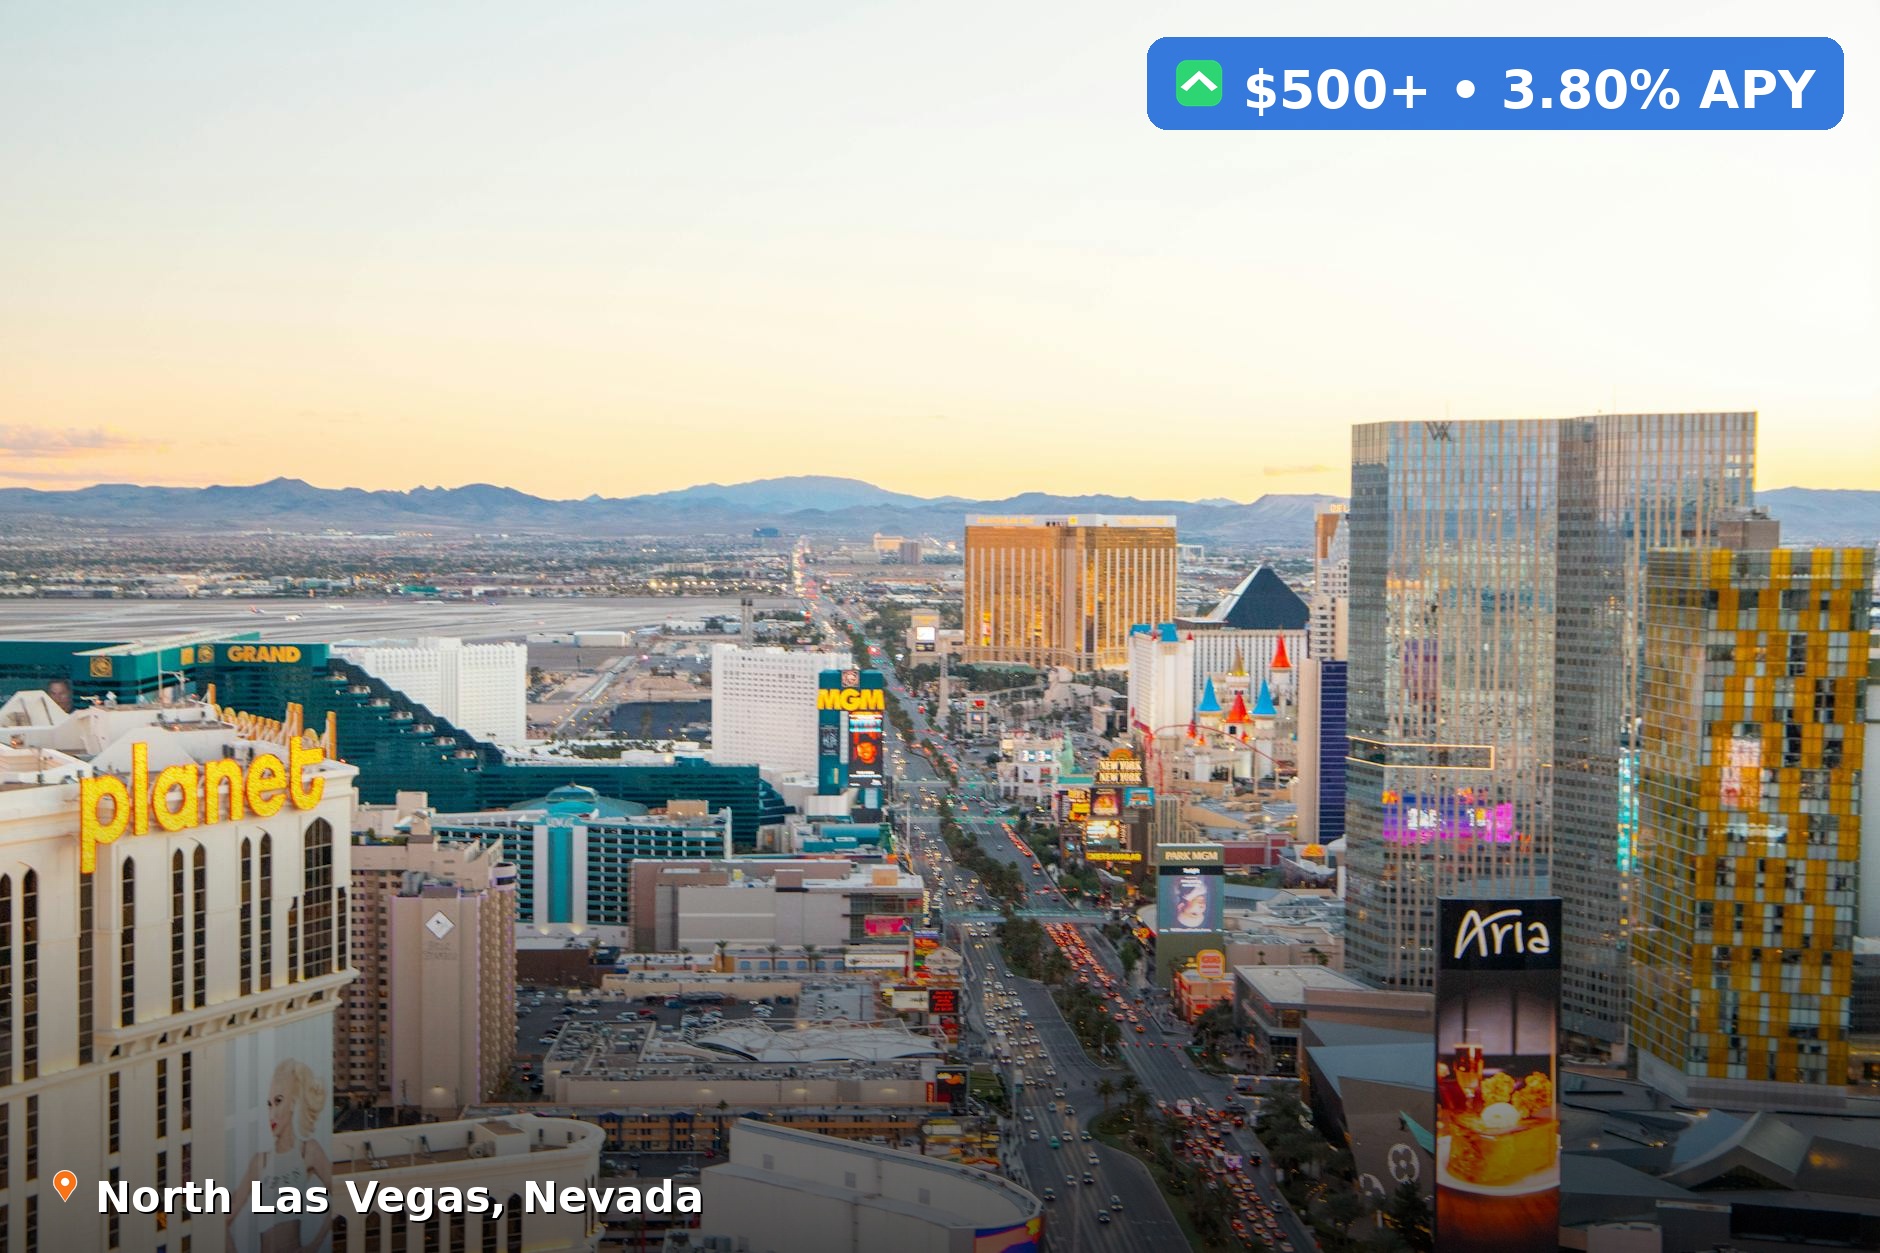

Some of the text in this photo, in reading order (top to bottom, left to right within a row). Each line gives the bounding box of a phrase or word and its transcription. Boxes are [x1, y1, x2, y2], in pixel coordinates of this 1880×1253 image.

[227, 645, 302, 664] GRAND
[816, 688, 886, 712] MGM
[1099, 760, 1142, 770] NEW YORK
[1099, 772, 1142, 782] NEW YORK
[80, 735, 326, 874] planet
[1164, 850, 1219, 861] PARK MGM
[1455, 909, 1550, 959] Aria
